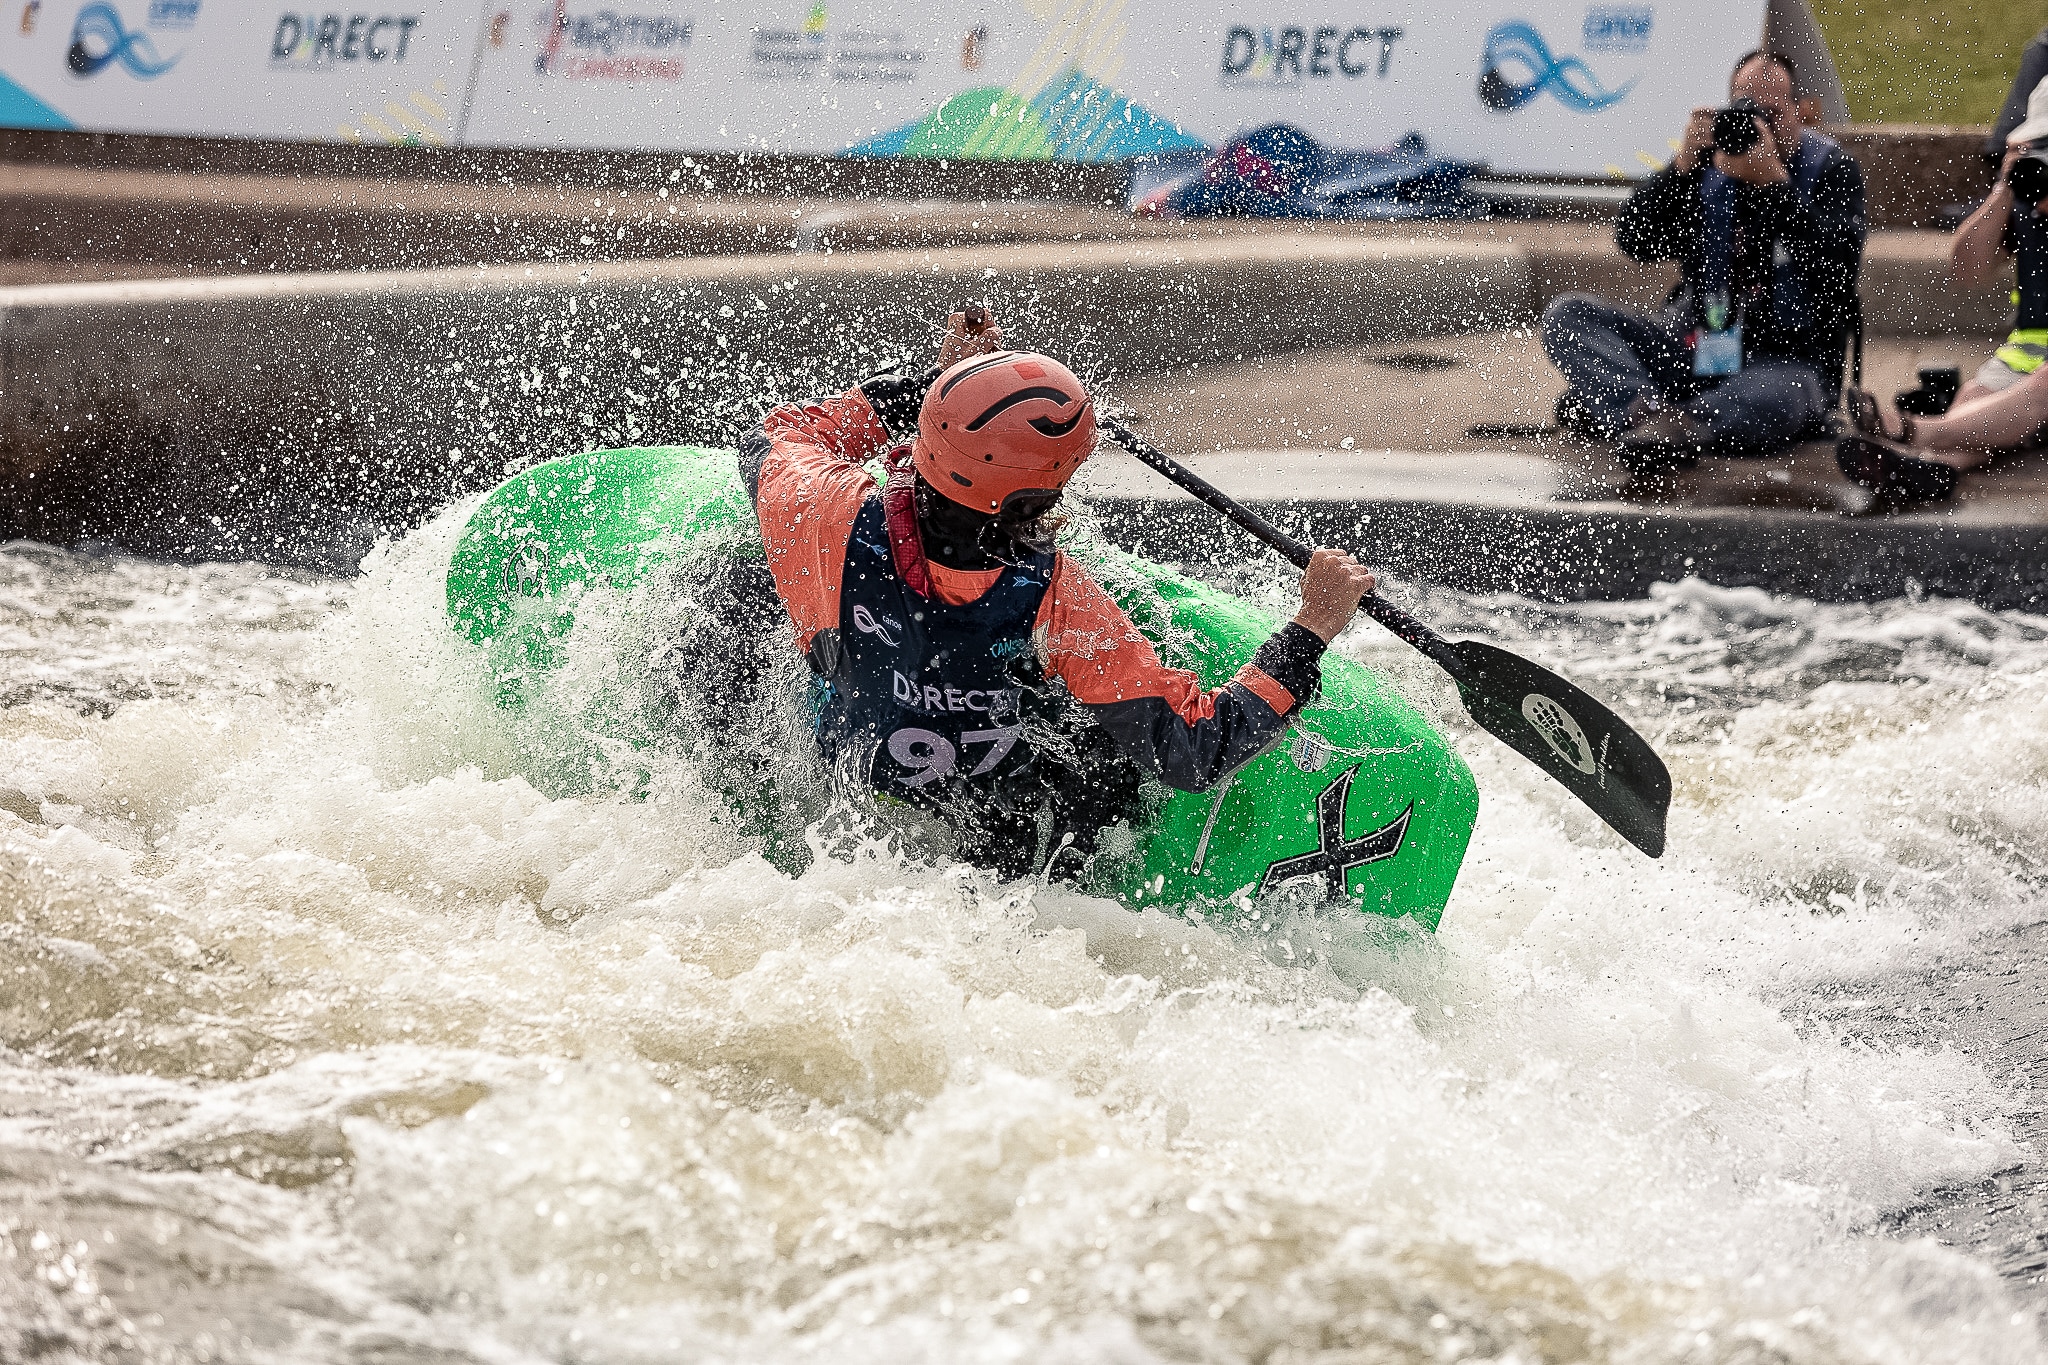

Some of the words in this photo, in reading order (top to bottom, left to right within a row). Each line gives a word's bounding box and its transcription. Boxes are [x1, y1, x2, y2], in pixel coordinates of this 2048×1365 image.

[1221, 25, 1403, 78] DIRECT
[882, 615, 902, 631] canoe
[887, 726, 1023, 787] 97
